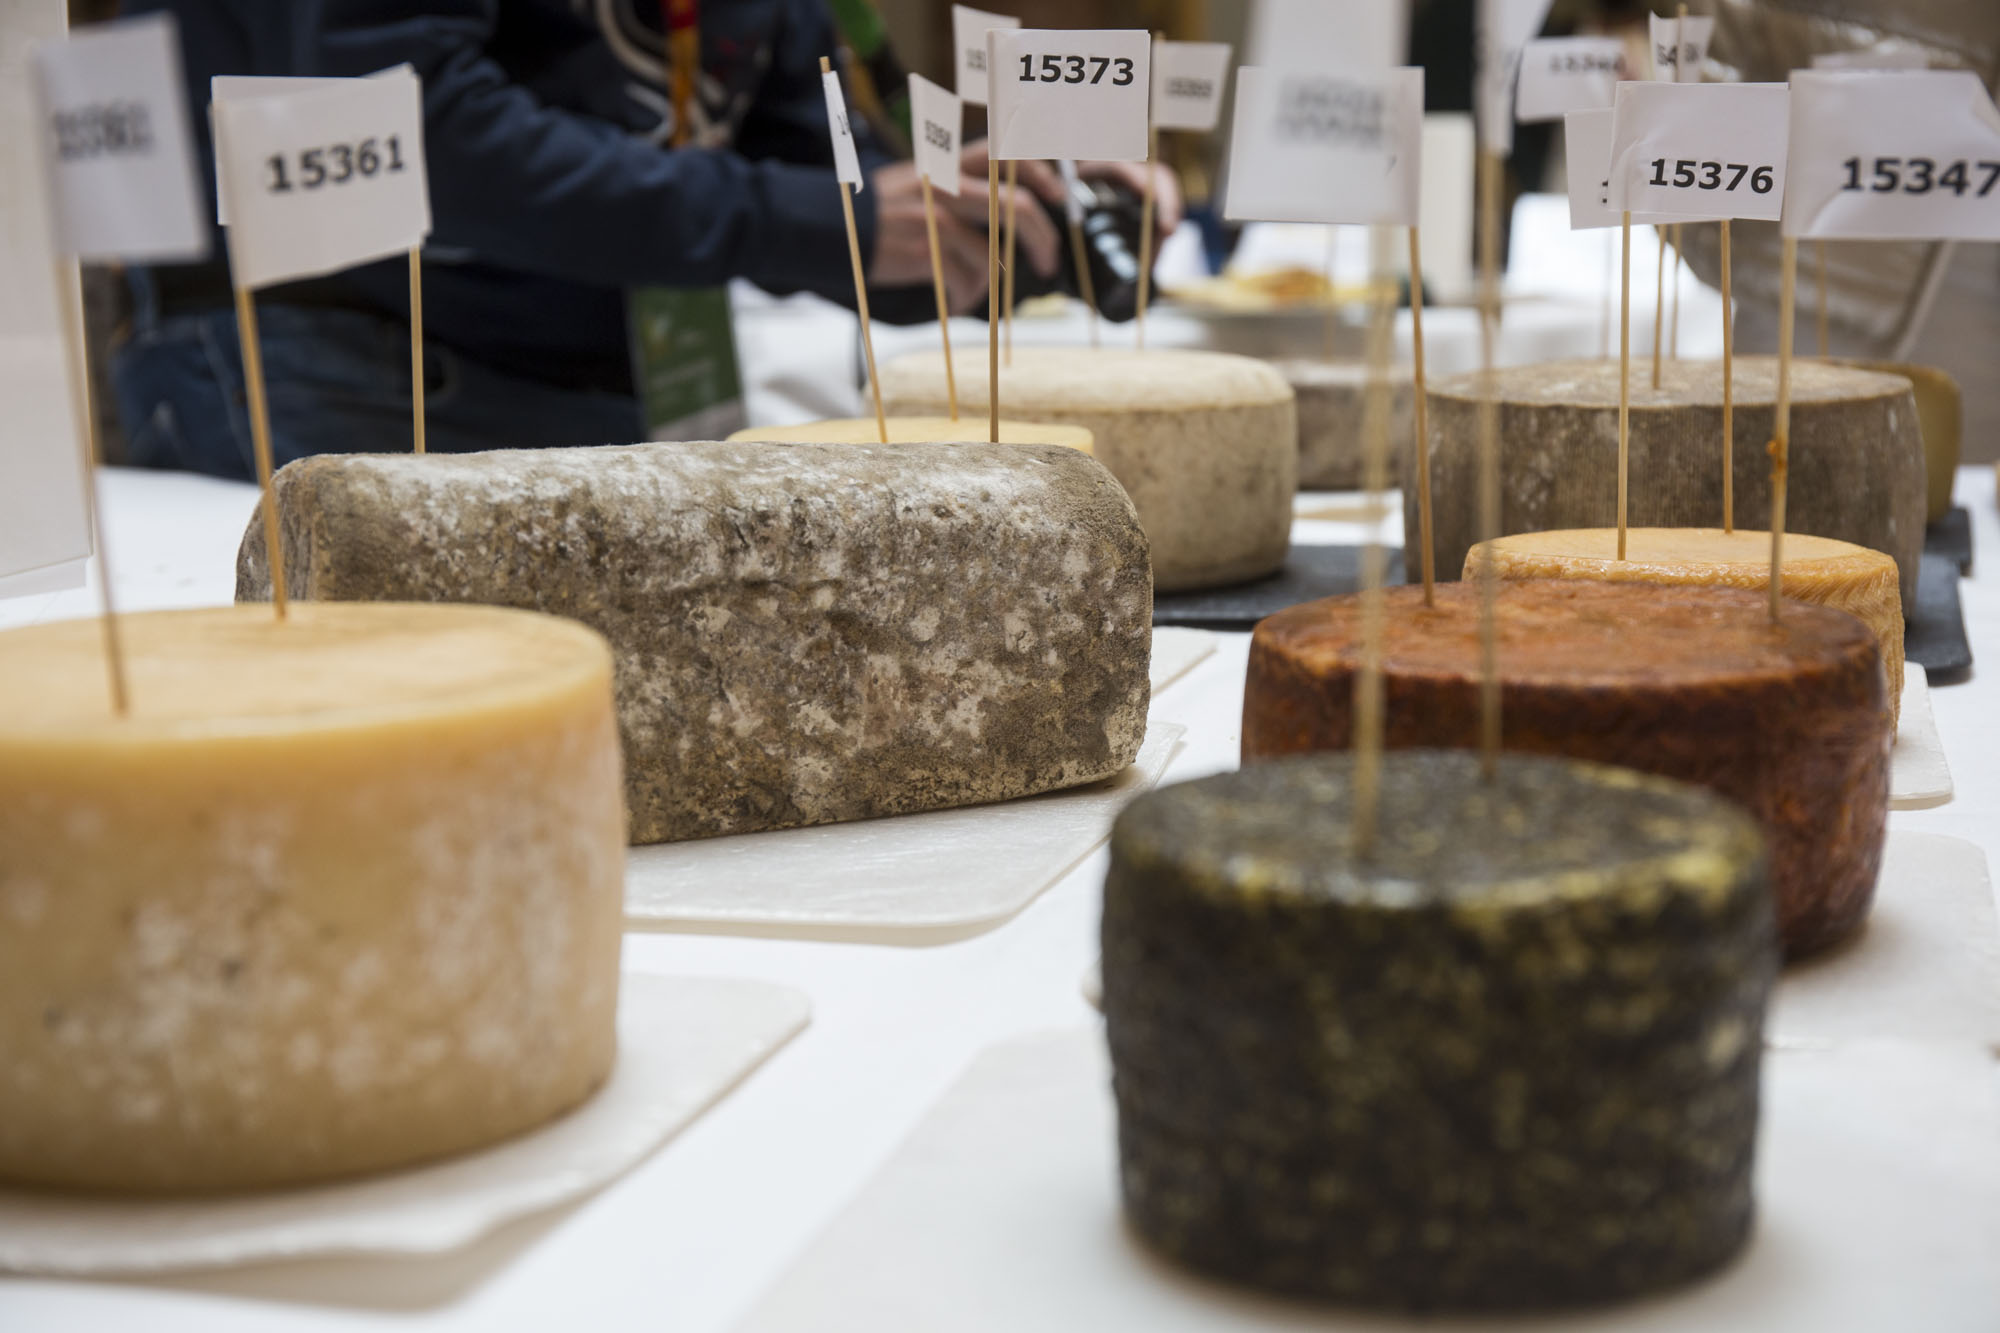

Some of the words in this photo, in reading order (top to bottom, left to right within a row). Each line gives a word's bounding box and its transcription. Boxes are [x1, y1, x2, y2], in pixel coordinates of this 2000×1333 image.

[1019, 54, 1134, 86] 15373
[266, 134, 404, 193] 15361
[1649, 158, 1774, 195] 15376
[1841, 156, 2000, 197] 15347
